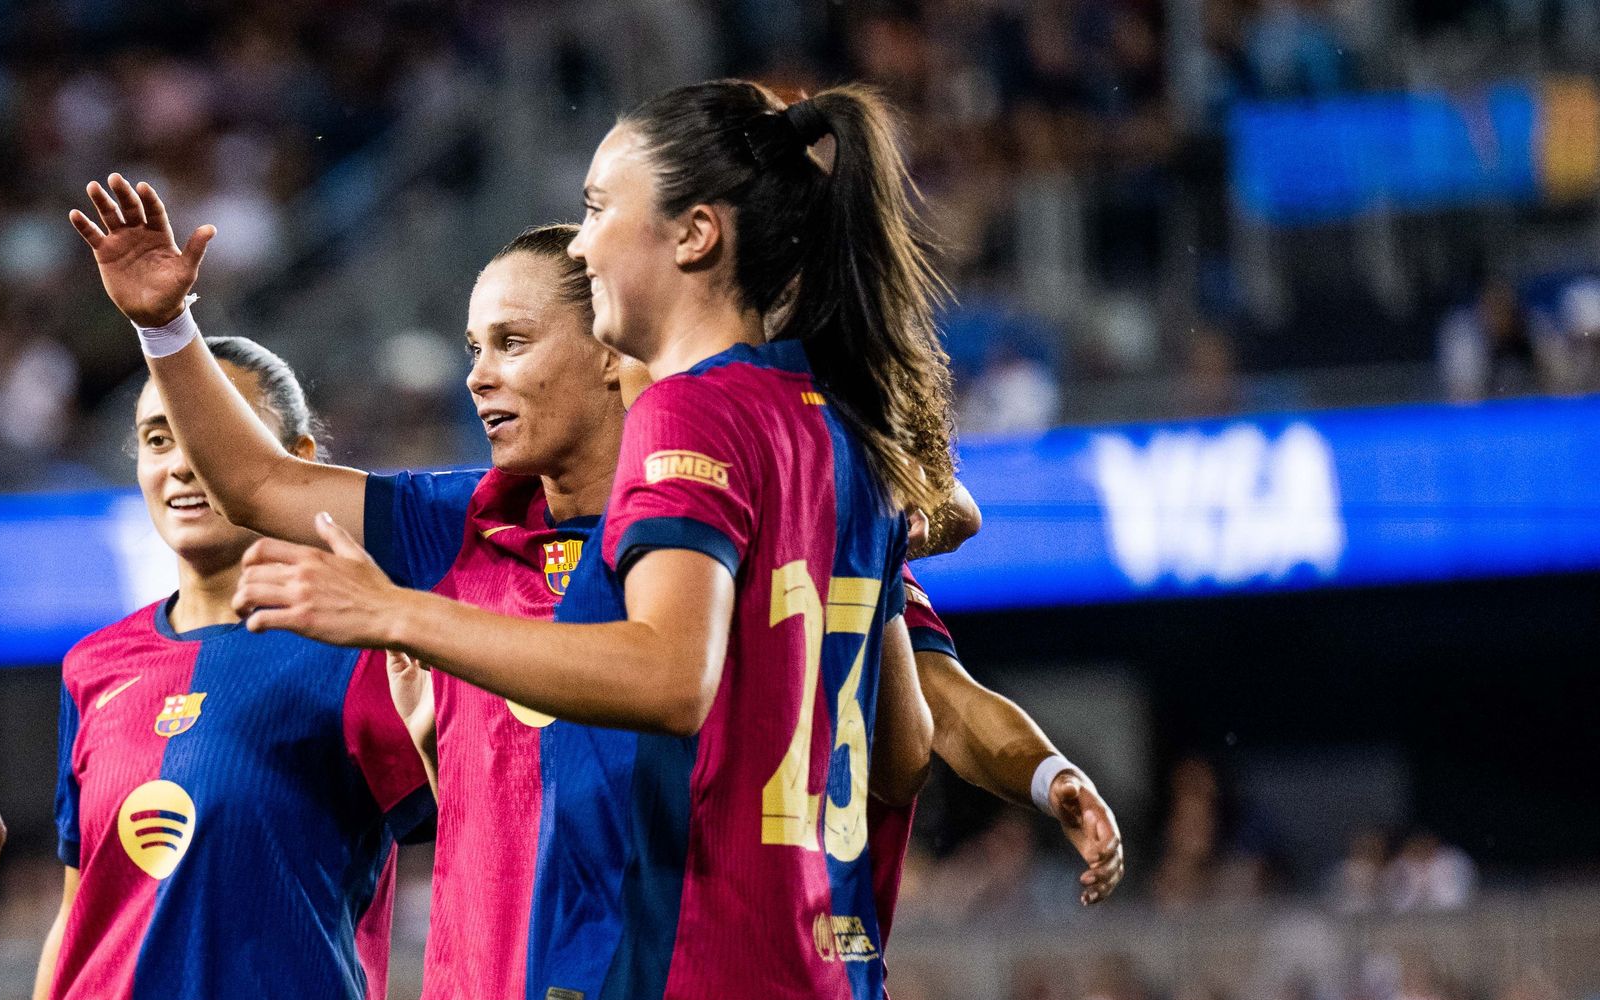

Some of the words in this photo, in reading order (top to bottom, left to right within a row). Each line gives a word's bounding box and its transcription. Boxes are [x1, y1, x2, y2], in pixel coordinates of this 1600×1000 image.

[646, 455, 728, 486] BIMBO
[1090, 424, 1344, 586] VISA
[761, 560, 882, 862] 23
